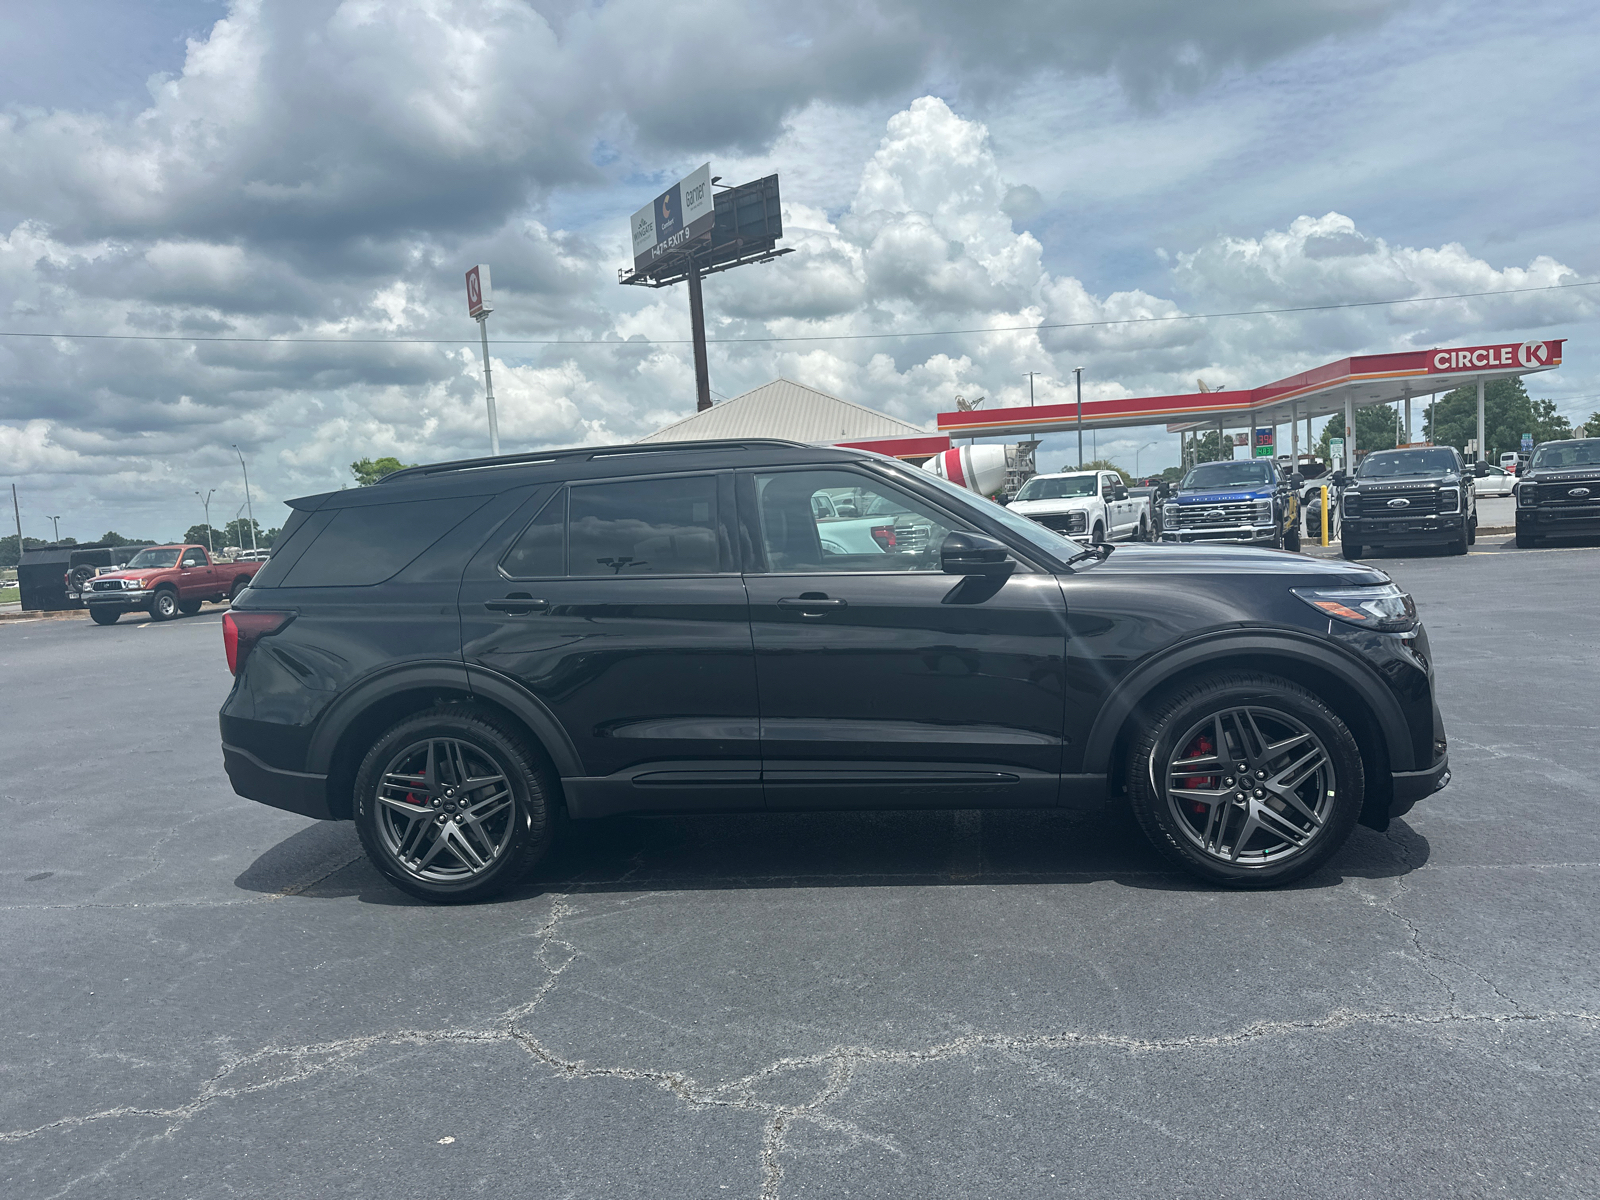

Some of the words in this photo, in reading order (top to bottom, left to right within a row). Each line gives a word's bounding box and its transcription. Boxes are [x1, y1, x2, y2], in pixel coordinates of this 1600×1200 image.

[668, 230, 684, 247] EXIT
[685, 227, 690, 239] 9
[1433, 347, 1512, 370] CIRCLE
[1523, 343, 1547, 367] K
